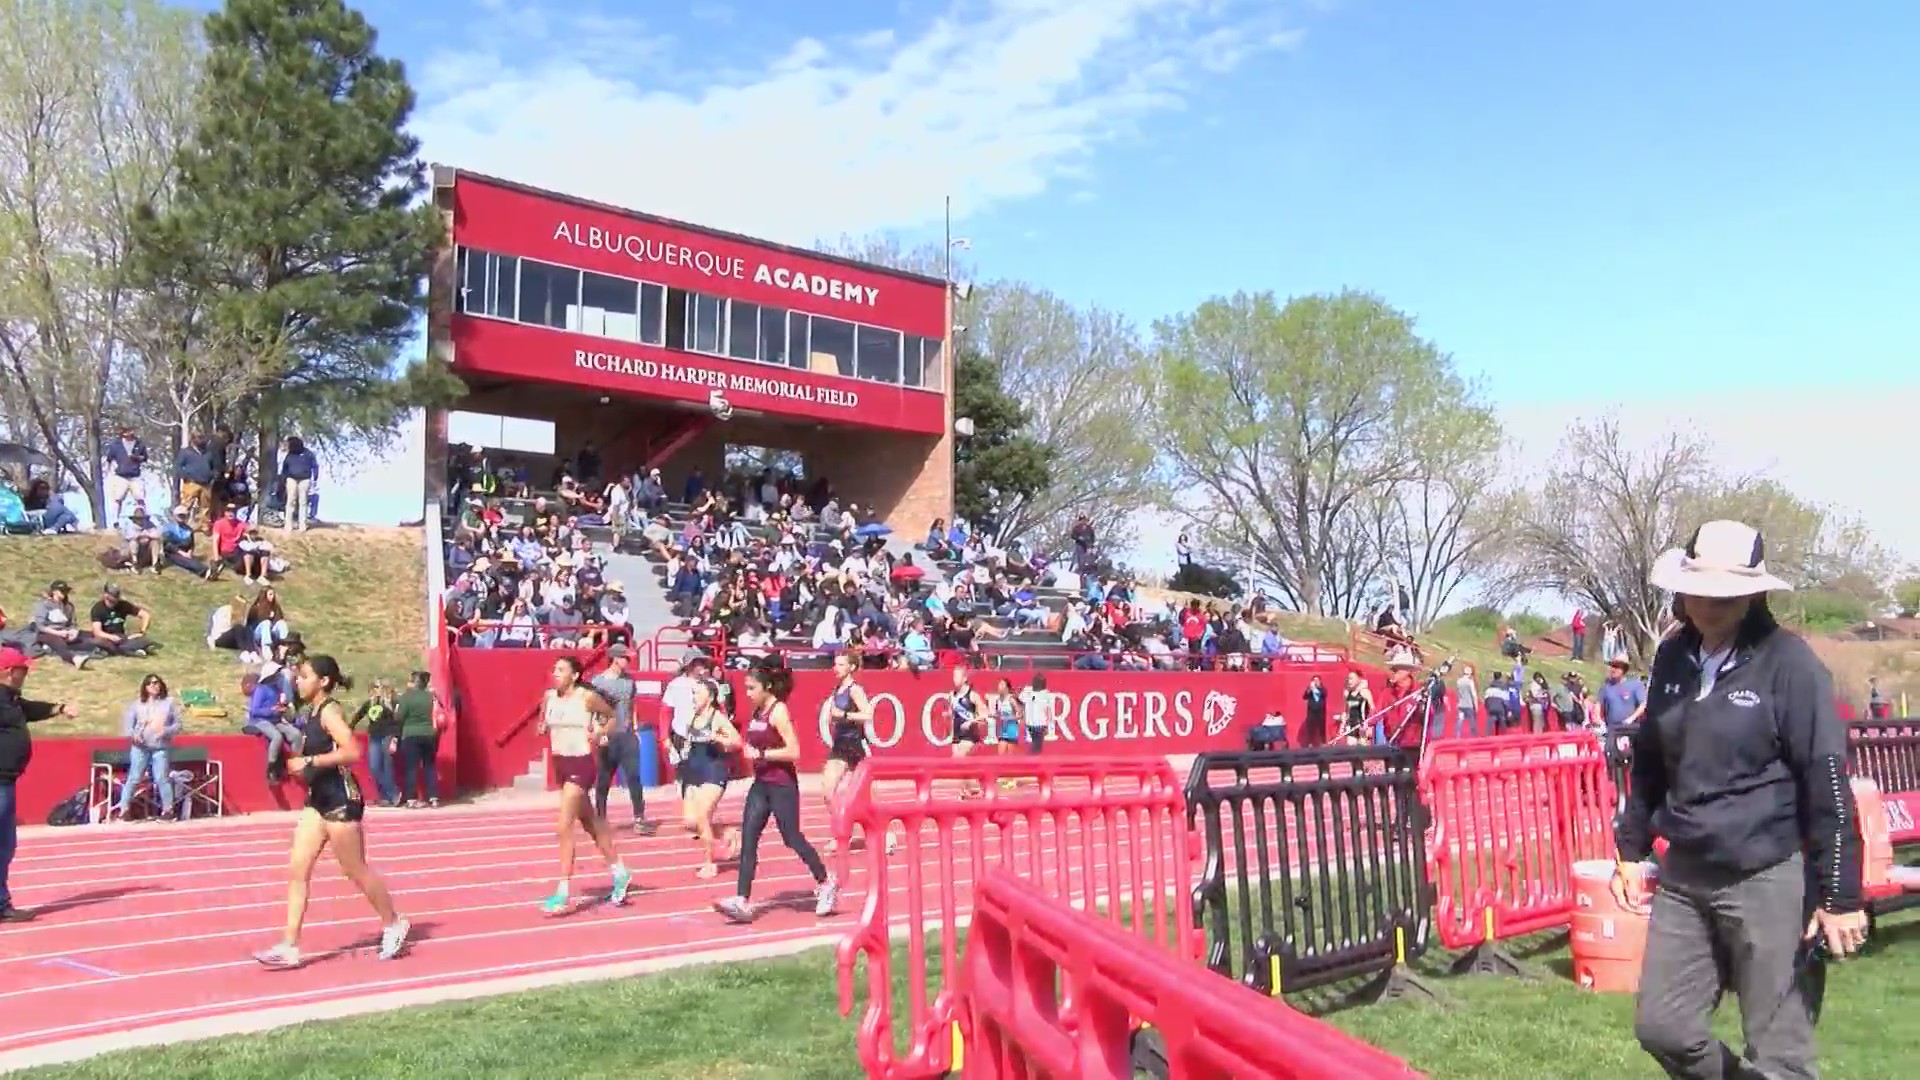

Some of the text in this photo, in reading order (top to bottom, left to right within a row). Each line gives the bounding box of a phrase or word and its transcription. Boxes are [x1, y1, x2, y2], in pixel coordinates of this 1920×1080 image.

[553, 221, 880, 307] ALBUQUERQUE ACADEMY
[574, 349, 858, 408] RICHARD HARPER MEMORIAL FIELD
[921, 689, 1193, 747] CRGERS
